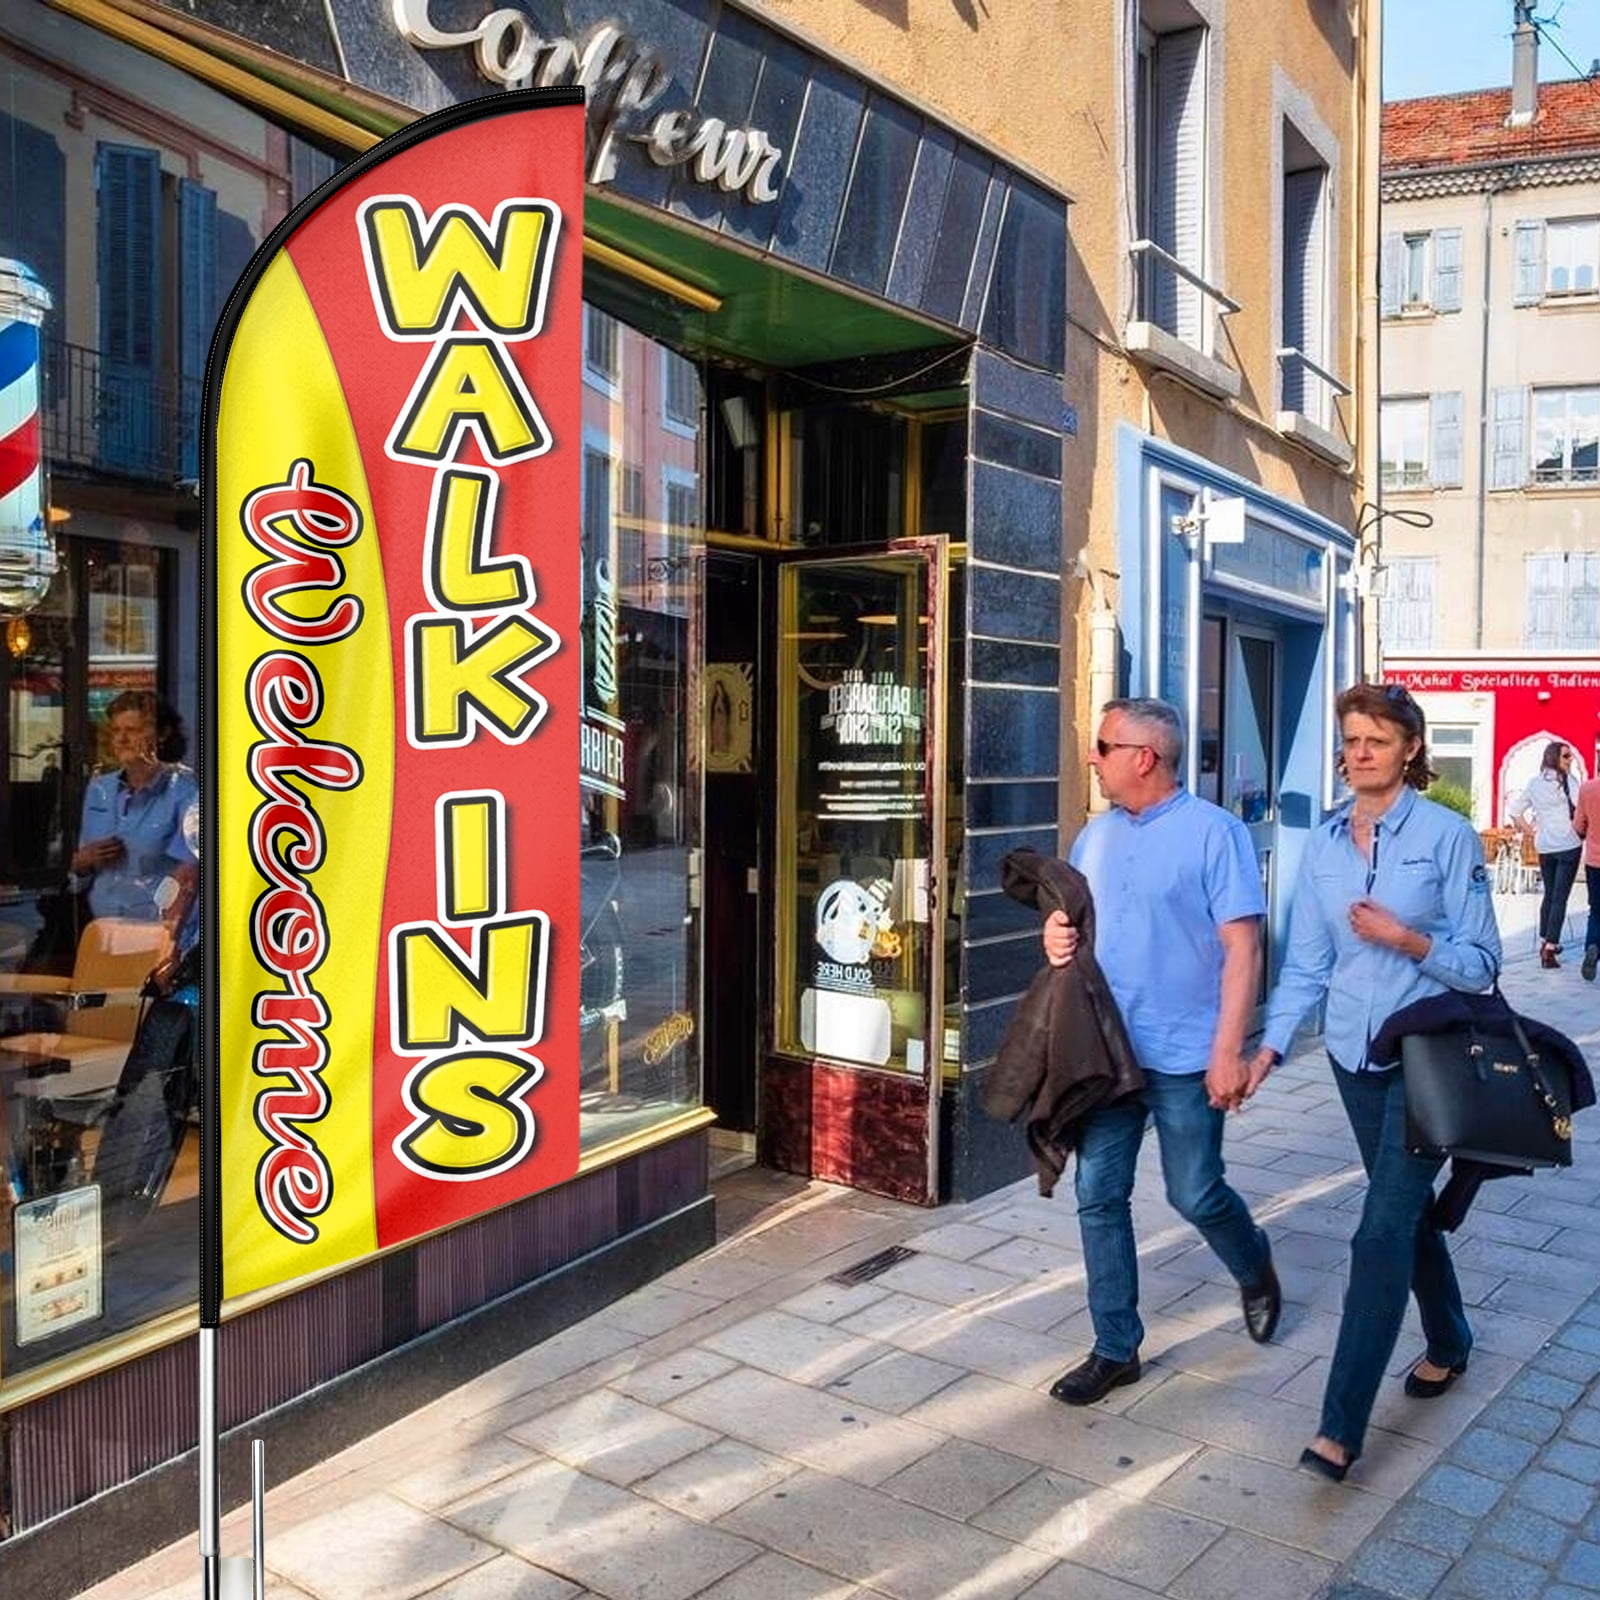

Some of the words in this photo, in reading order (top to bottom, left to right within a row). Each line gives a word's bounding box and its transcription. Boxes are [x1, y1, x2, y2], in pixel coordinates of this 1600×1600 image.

[356, 194, 563, 749] WALK
[240, 458, 365, 1246] Welcome
[389, 788, 553, 1183] INS
[580, 722, 625, 784] RBIER
